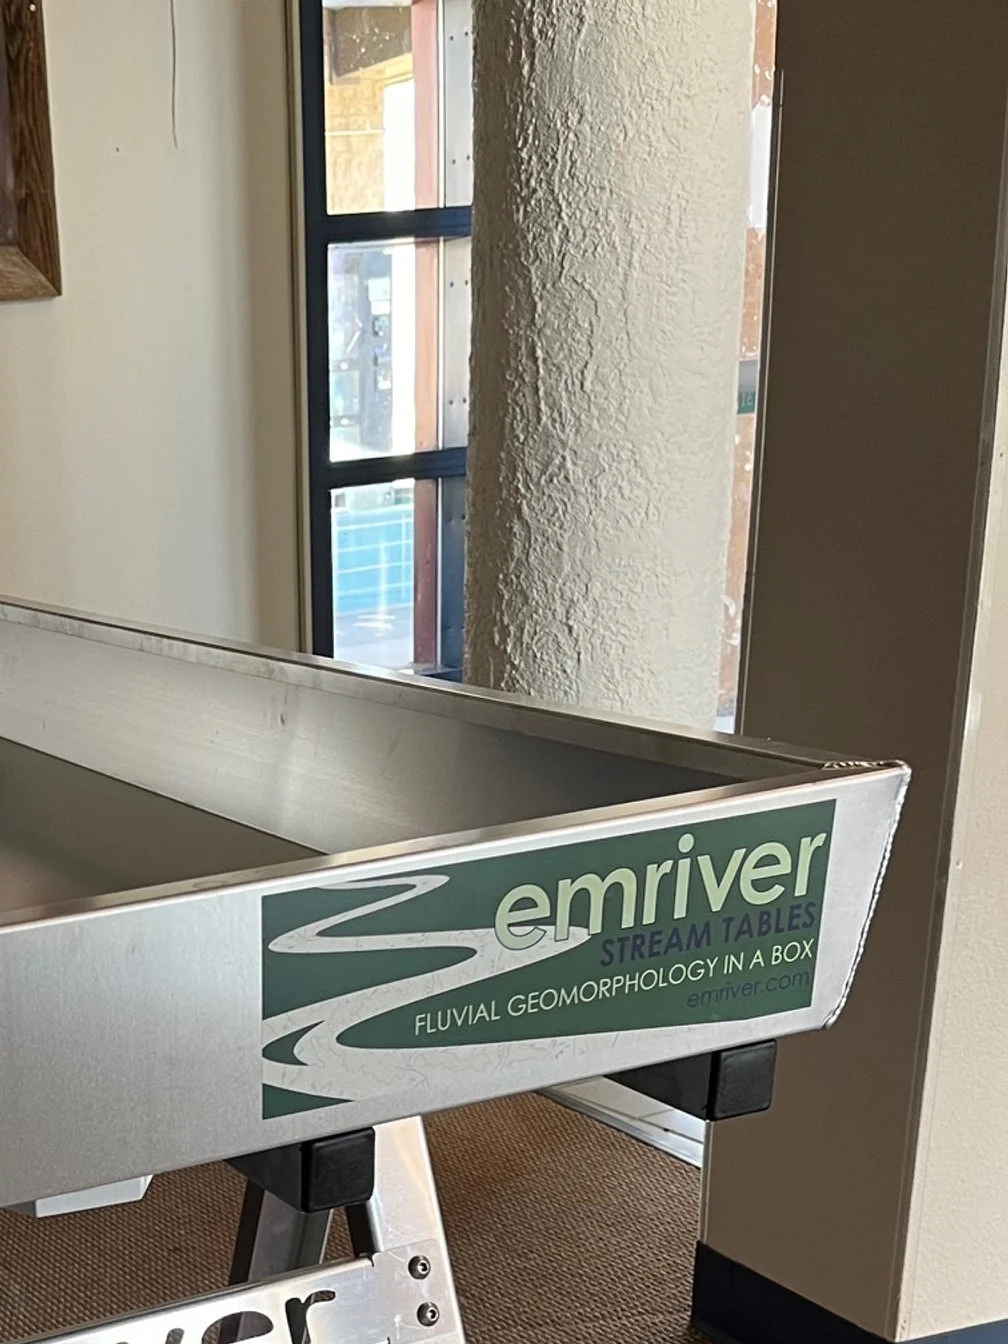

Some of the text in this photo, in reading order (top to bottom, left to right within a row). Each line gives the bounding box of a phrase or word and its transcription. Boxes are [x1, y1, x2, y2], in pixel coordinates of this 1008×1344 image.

[495, 832, 826, 950] emriver
[600, 902, 817, 967] STREAM TABLES
[414, 938, 813, 1036] FLUVIAL GEOMORPHOLOGY IN A BOX
[686, 968, 811, 1008] emriver.com
